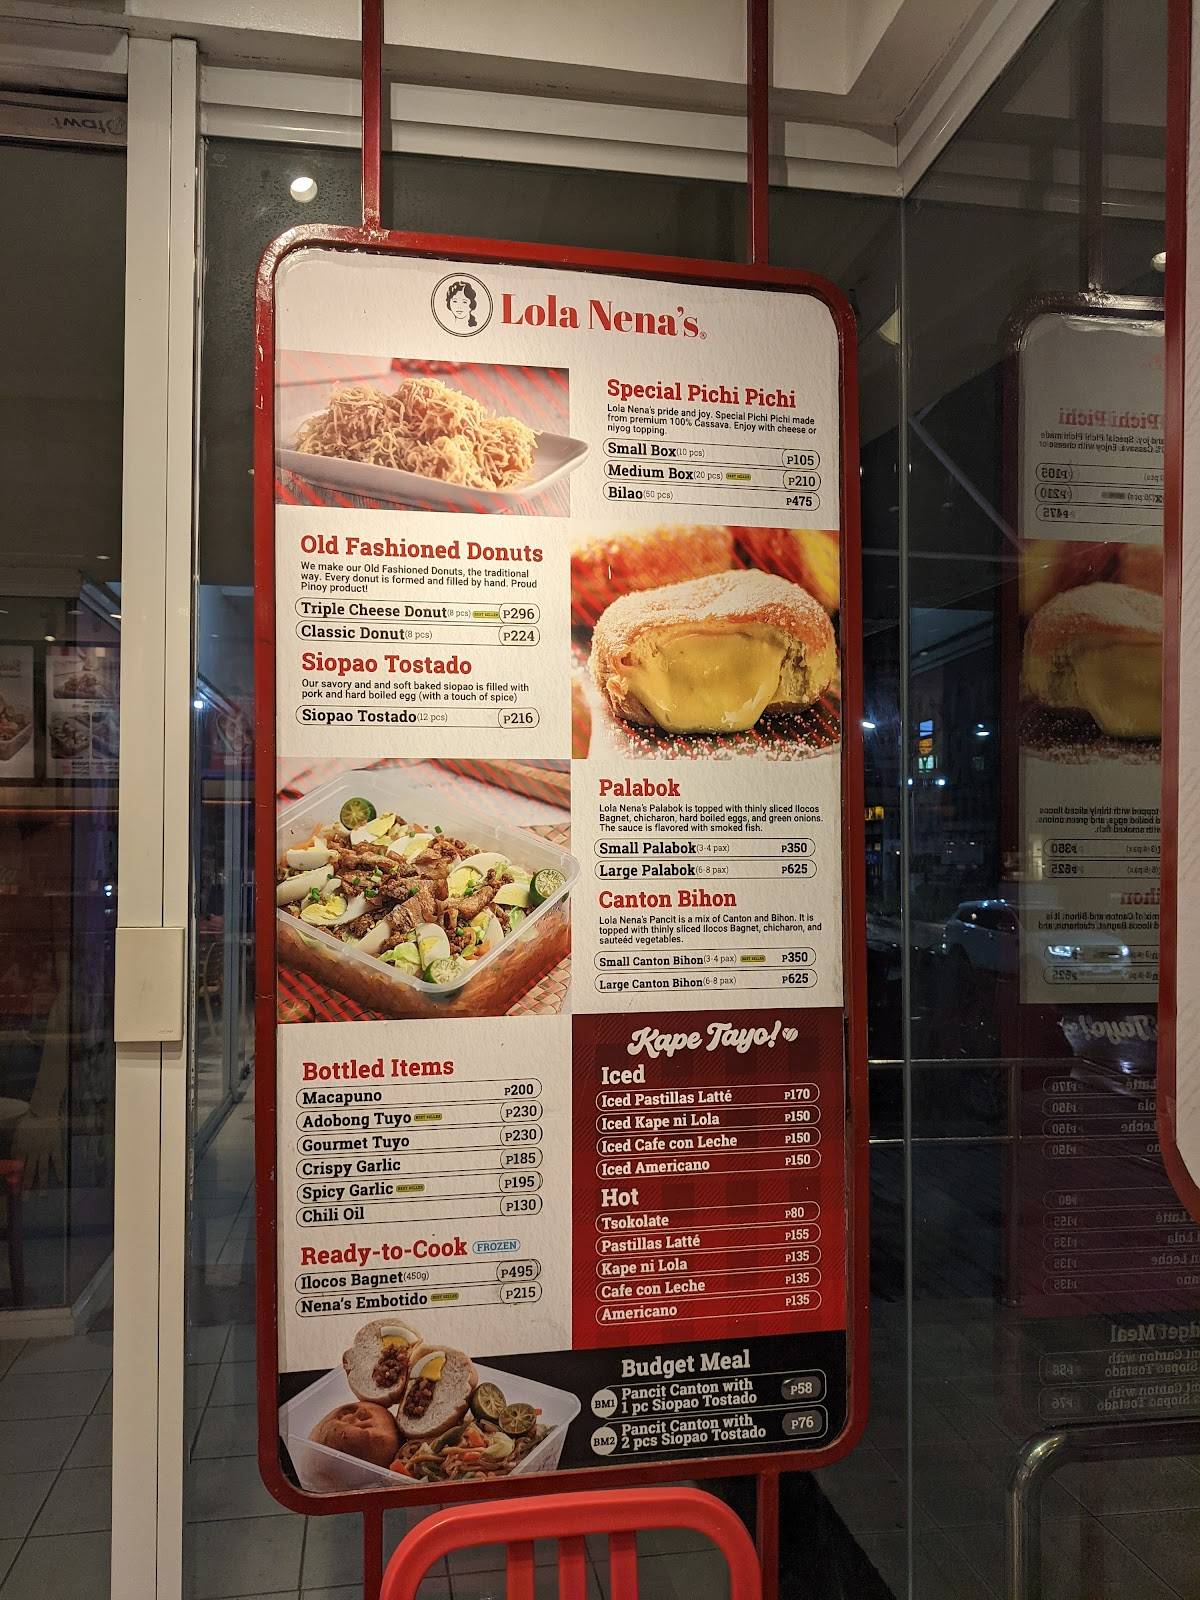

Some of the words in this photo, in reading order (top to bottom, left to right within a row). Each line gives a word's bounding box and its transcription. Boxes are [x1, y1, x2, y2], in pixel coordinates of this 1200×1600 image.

[501, 293, 579, 328] Lola
[589, 300, 699, 339] Nena's
[608, 379, 681, 401] Special
[688, 384, 739, 404] Pichi
[746, 388, 796, 408] Pichi
[607, 425, 631, 434] niyog
[633, 426, 667, 436] topping.
[608, 443, 646, 455] Small
[787, 455, 814, 465] P105
[608, 464, 664, 478] Medium
[788, 476, 815, 486] P210
[786, 496, 812, 506] P475
[301, 535, 339, 555] Old
[346, 537, 460, 559] Fashioned
[467, 542, 543, 562] Donuts
[301, 561, 316, 570] We
[318, 562, 343, 571] make
[364, 564, 379, 573] Old
[382, 564, 429, 574] Fashioned
[431, 567, 465, 577] Donuts,
[468, 568, 482, 576] the
[484, 568, 529, 578] traditional
[301, 573, 322, 583] way.
[325, 574, 350, 583] Every
[352, 574, 379, 583] donut
[382, 575, 389, 583] is
[392, 576, 425, 585] formed
[427, 577, 444, 585] and
[446, 577, 468, 586] filled
[471, 578, 481, 588] by
[484, 578, 508, 587] hand.
[511, 579, 537, 588] Proud
[301, 582, 327, 593] Pinoy
[330, 583, 368, 594] product!
[301, 602, 345, 618] Triple
[349, 604, 400, 617] Cheese
[503, 608, 534, 619] P296
[301, 625, 355, 638] Classic
[503, 631, 535, 642] P224
[302, 652, 377, 676] Siopao
[384, 654, 472, 674] Tostado
[302, 709, 353, 724] Siopao
[504, 712, 533, 724] P216
[600, 778, 680, 797] Palabok
[600, 842, 638, 854] Small
[782, 843, 808, 853] P350
[600, 865, 638, 879] Large
[782, 864, 808, 874] P625
[600, 891, 672, 908] Canton
[678, 889, 737, 907] Bihon
[600, 957, 630, 966] Small
[633, 957, 670, 966] Canton
[782, 952, 808, 962] P350
[600, 980, 629, 990] Large
[632, 979, 670, 989] Canton
[782, 973, 808, 984] P625
[627, 1027, 703, 1058] Kape
[706, 1020, 782, 1054] Tayo!
[303, 1059, 384, 1080] Bottled
[391, 1058, 454, 1078] Items
[602, 1064, 645, 1085] Iced
[504, 1084, 534, 1096] P200
[784, 1089, 810, 1100] P170
[303, 1091, 382, 1106] Macapuno
[602, 1094, 631, 1108] Iced
[634, 1092, 694, 1106] Pastillas
[698, 1090, 732, 1103] Latté
[506, 1106, 537, 1117] P230
[785, 1110, 810, 1122] P150
[303, 1114, 369, 1128] Adobong
[374, 1112, 411, 1127] Tuyo
[602, 1117, 631, 1130] Iced
[635, 1116, 669, 1131] Kape
[673, 1114, 687, 1127] ni
[690, 1112, 720, 1126] Lola
[505, 1129, 537, 1141] P230
[785, 1132, 810, 1144] P150
[303, 1137, 368, 1151] Gourmet
[372, 1136, 409, 1150] Tuyo
[602, 1140, 631, 1153] Iced
[635, 1138, 665, 1151] Cafe
[669, 1139, 693, 1150] con
[698, 1134, 737, 1148] Leche
[506, 1153, 536, 1164] P185
[785, 1154, 811, 1165] P150
[302, 1161, 352, 1176] Crispy
[356, 1158, 401, 1173] Garlic
[602, 1162, 631, 1176] Iced
[635, 1160, 710, 1174] Americano
[505, 1176, 535, 1188] P195
[302, 1185, 344, 1201] Spicy
[349, 1182, 393, 1196] Garlic
[602, 1188, 639, 1207] Hot
[506, 1199, 536, 1211] P130
[302, 1209, 338, 1222] Chili
[343, 1207, 364, 1220] Oil
[785, 1207, 804, 1218] P80
[602, 1214, 669, 1229] Tsokolate
[785, 1229, 809, 1241] P155
[602, 1237, 662, 1253] Pastillas
[666, 1234, 700, 1249] Latté
[301, 1237, 468, 1266] Ready-to-Cook
[477, 1241, 517, 1252] FROZEN
[786, 1251, 809, 1262] P135
[501, 1266, 533, 1278] P495
[602, 1262, 636, 1278] Kape
[640, 1260, 655, 1272] ni
[658, 1258, 688, 1271] Lola
[301, 1274, 346, 1289] Ilocos
[786, 1272, 809, 1284] P135
[506, 1286, 536, 1299] P215
[602, 1284, 632, 1298] Cafe
[636, 1284, 661, 1295] con
[665, 1280, 705, 1293] Leche
[301, 1298, 351, 1312] Nena's
[356, 1293, 428, 1309] Embotido
[786, 1294, 810, 1306] P135
[602, 1305, 677, 1320] Americano
[622, 1355, 694, 1379] Budget
[700, 1349, 750, 1371] Meal
[594, 1400, 615, 1409] BM1
[622, 1385, 666, 1400] Pancit
[670, 1381, 719, 1395] Canton
[722, 1378, 753, 1391] with
[791, 1382, 812, 1394] P58
[622, 1401, 628, 1413] 1
[632, 1400, 648, 1415] pc
[652, 1395, 699, 1413] Siopao
[702, 1391, 757, 1407] Tostado
[791, 1416, 813, 1429] P76
[594, 1437, 615, 1446] BM2
[622, 1421, 666, 1436] Pancit
[670, 1417, 719, 1431] Canton
[722, 1414, 753, 1427] with
[622, 1437, 630, 1448] 2
[634, 1434, 658, 1450] pcs
[661, 1429, 708, 1447] Siopao
[712, 1425, 766, 1441] Tostado
